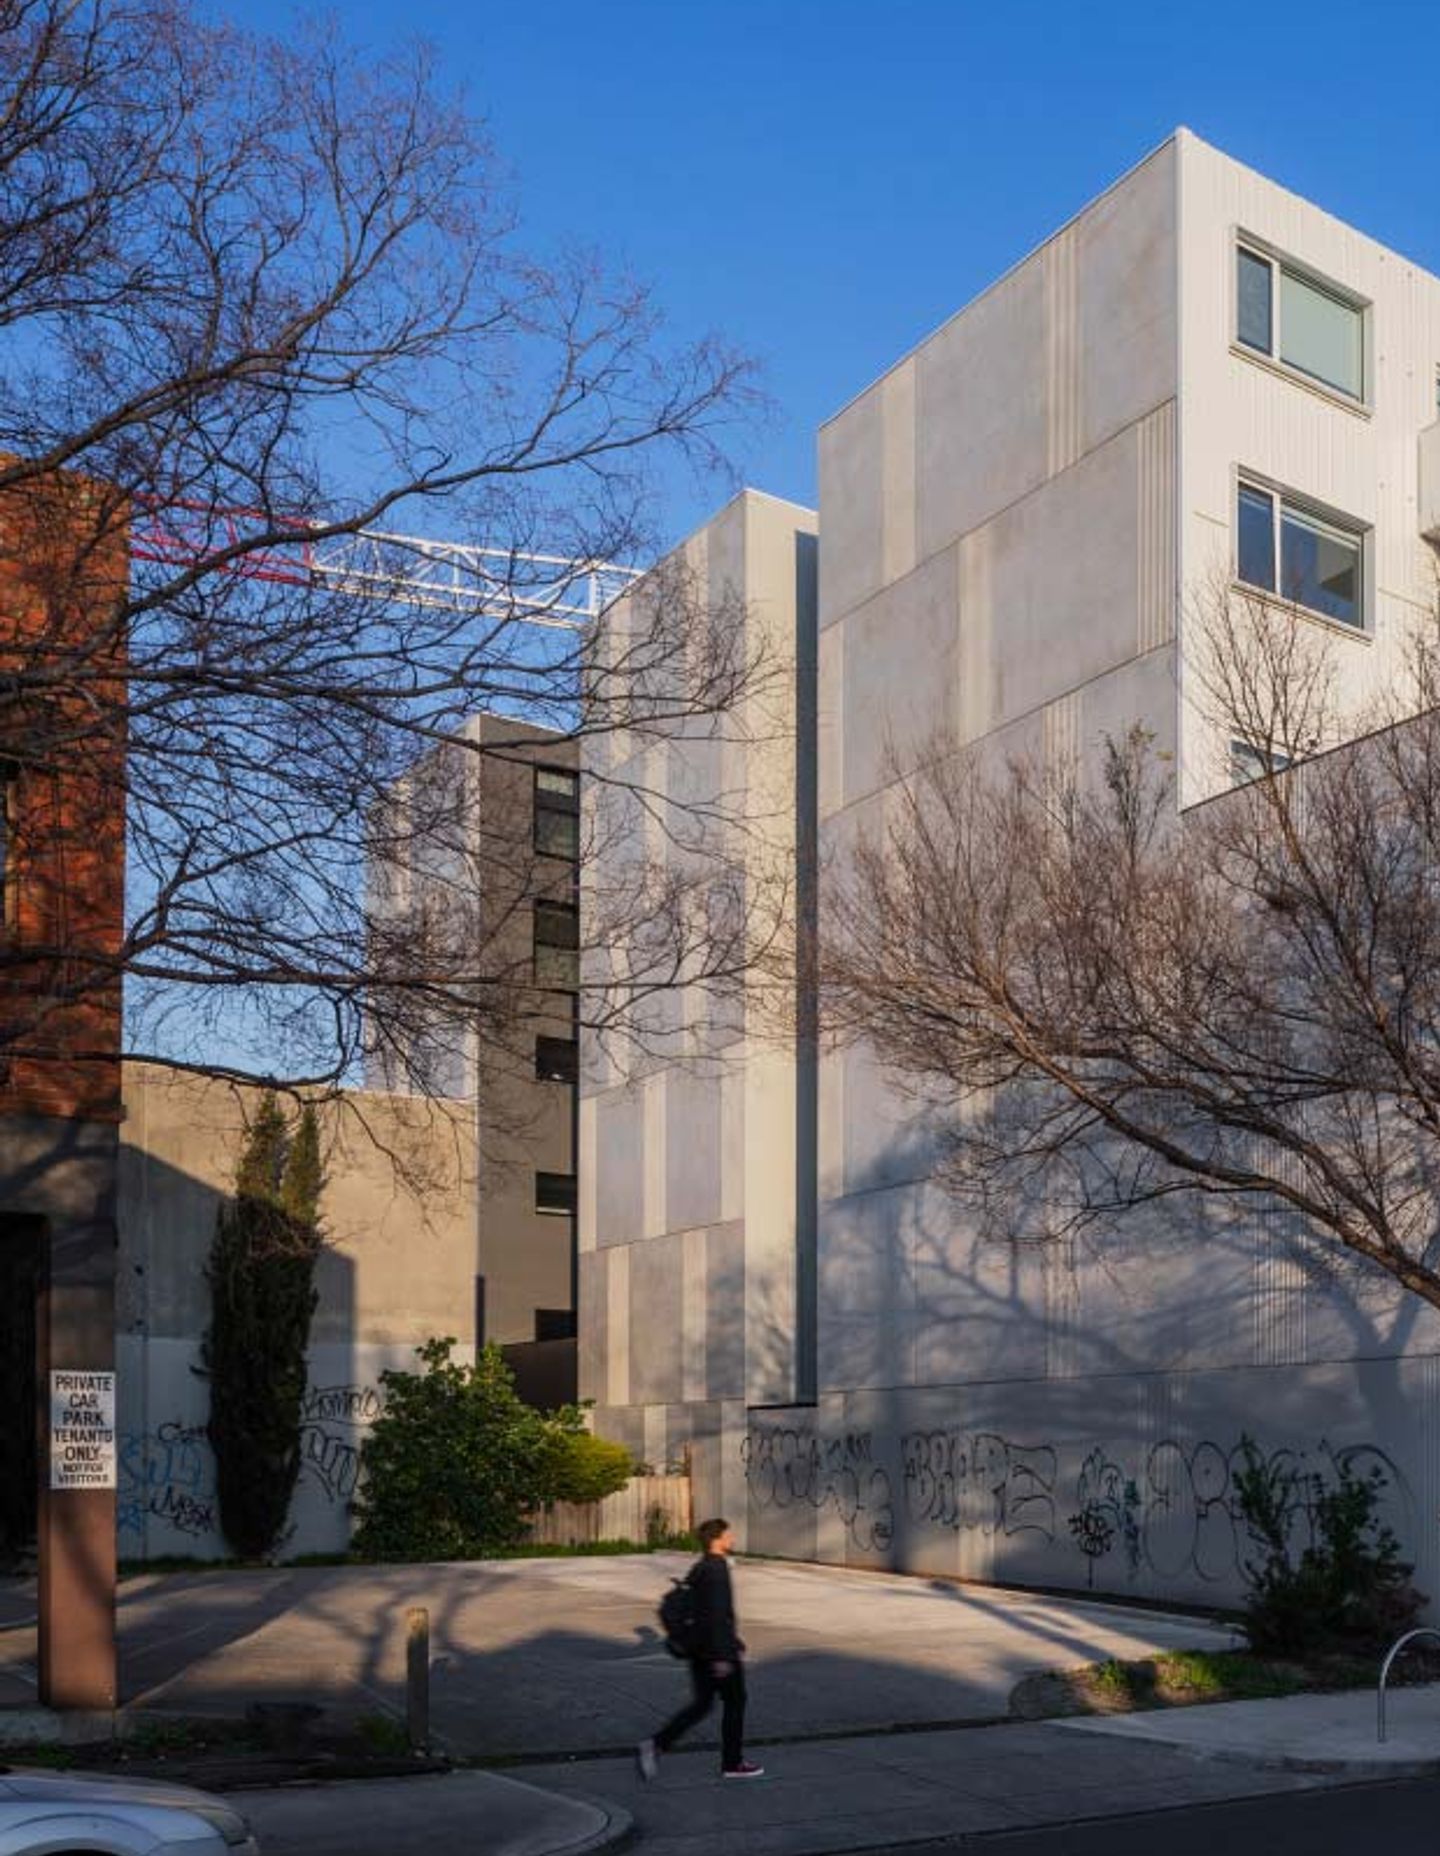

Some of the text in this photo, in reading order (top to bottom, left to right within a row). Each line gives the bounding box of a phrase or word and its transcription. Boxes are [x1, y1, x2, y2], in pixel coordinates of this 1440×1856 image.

[55, 1375, 112, 1392] PRIVATE
[69, 1393, 99, 1408] CAR
[63, 1411, 105, 1426] PARK
[54, 1429, 112, 1443] TENANTS
[65, 1446, 101, 1461] ONLY
[63, 1463, 82, 1473] NOT
[58, 1474, 109, 1483] VISITORS
